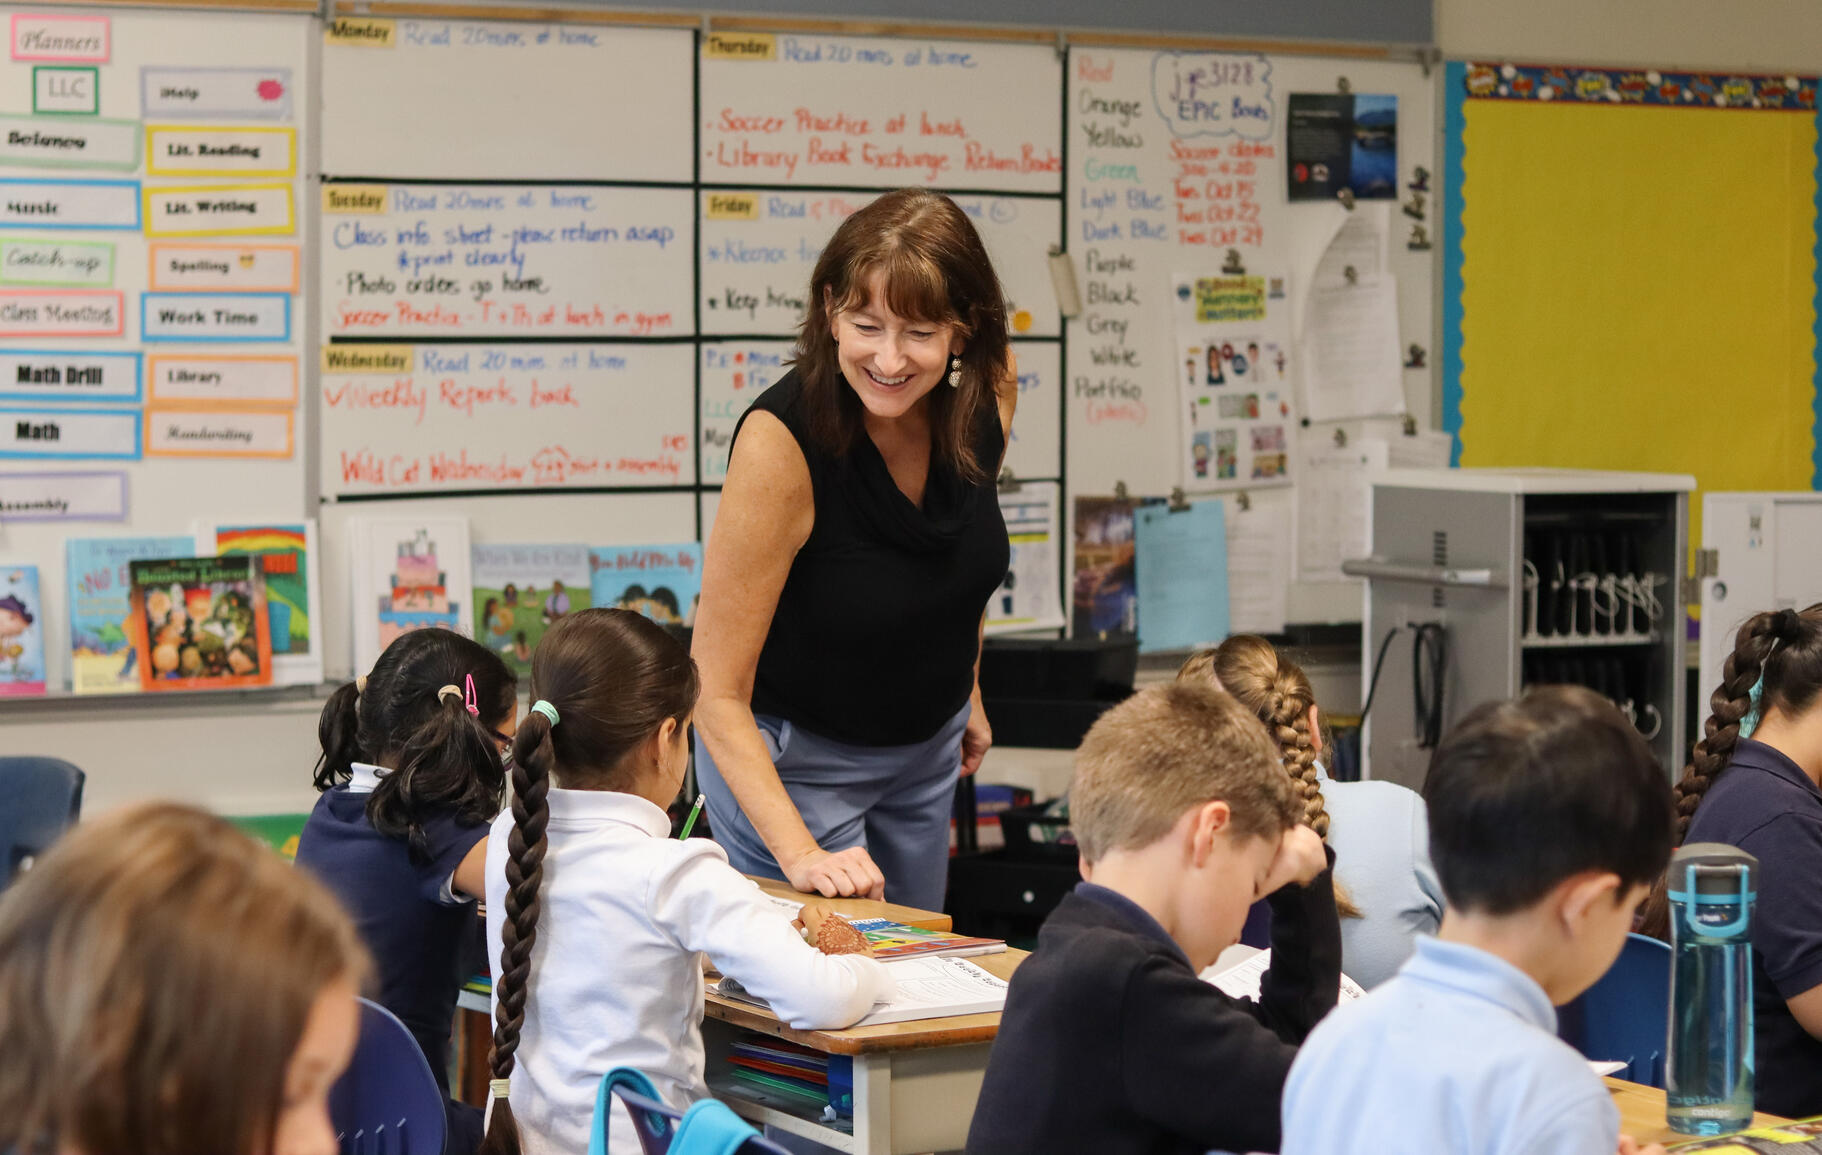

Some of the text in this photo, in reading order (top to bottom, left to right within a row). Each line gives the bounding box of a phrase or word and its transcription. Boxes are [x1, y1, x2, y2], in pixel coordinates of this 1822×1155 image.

[21, 29, 101, 51] Planners
[329, 21, 392, 42] Monday
[404, 22, 450, 46] Read
[559, 24, 600, 47] home
[710, 37, 771, 58] Thursday
[784, 37, 822, 63] Read
[827, 39, 850, 61] 20
[905, 49, 922, 66] at
[928, 46, 978, 68] home
[1078, 55, 1115, 83] Red
[49, 77, 87, 98] LLC
[1079, 87, 1143, 128] Orange
[1178, 101, 1221, 121] EPIC
[718, 107, 967, 138] Soccer Practice at lunch
[1081, 121, 1143, 149] Yellow
[198, 145, 260, 159] Reading
[717, 139, 798, 178] Library
[808, 138, 850, 165] Book
[862, 141, 951, 181] Exchange
[965, 140, 1020, 172] Return
[1085, 157, 1142, 184] Green
[328, 190, 384, 210] Tuesday
[394, 190, 437, 211] Read
[550, 191, 596, 210] home
[1205, 180, 1233, 200] Oct
[1236, 180, 1255, 200] 15
[7, 202, 60, 215] Music
[197, 200, 257, 214] Writing
[710, 195, 754, 216] Friday
[768, 196, 806, 217] Read
[1081, 187, 1166, 221] Light Blue
[1207, 204, 1234, 223] Oct
[1237, 200, 1260, 223] 22
[333, 222, 387, 250] Class
[397, 220, 430, 245] info
[444, 223, 492, 245] sheet
[561, 221, 618, 243] return
[625, 225, 675, 249] asap
[1082, 219, 1168, 242] Dark Blue
[1210, 227, 1237, 247] Oct
[6, 249, 101, 278] Catch-up
[170, 260, 229, 273] Spelling
[465, 248, 526, 280] clearly
[1087, 250, 1136, 275] Purple
[347, 271, 550, 301] Photo orders go home
[1087, 280, 1140, 305] Black
[726, 287, 756, 319] Keep
[1, 305, 114, 325] Class Meeting
[160, 310, 258, 324] Work Time
[335, 301, 390, 330] Soccer
[396, 300, 460, 326] Practice
[478, 300, 497, 324] T
[511, 303, 533, 326] Th
[536, 304, 556, 325] at
[564, 303, 606, 327] lunch
[613, 310, 630, 324] in
[634, 310, 672, 334] gym
[1087, 315, 1128, 344] Grey
[326, 352, 408, 371] Wednesday
[422, 350, 470, 373] Read
[480, 350, 505, 371] 20
[588, 350, 626, 371] home
[1091, 348, 1142, 367] White
[17, 366, 103, 385] Math Drill
[168, 370, 222, 386] Library
[350, 378, 579, 427] Weekly Reports back
[16, 422, 60, 441] Math
[167, 427, 253, 443] Handwriting
[341, 450, 385, 484] Wild
[389, 455, 421, 484] Cat
[429, 450, 527, 484] Wednesday
